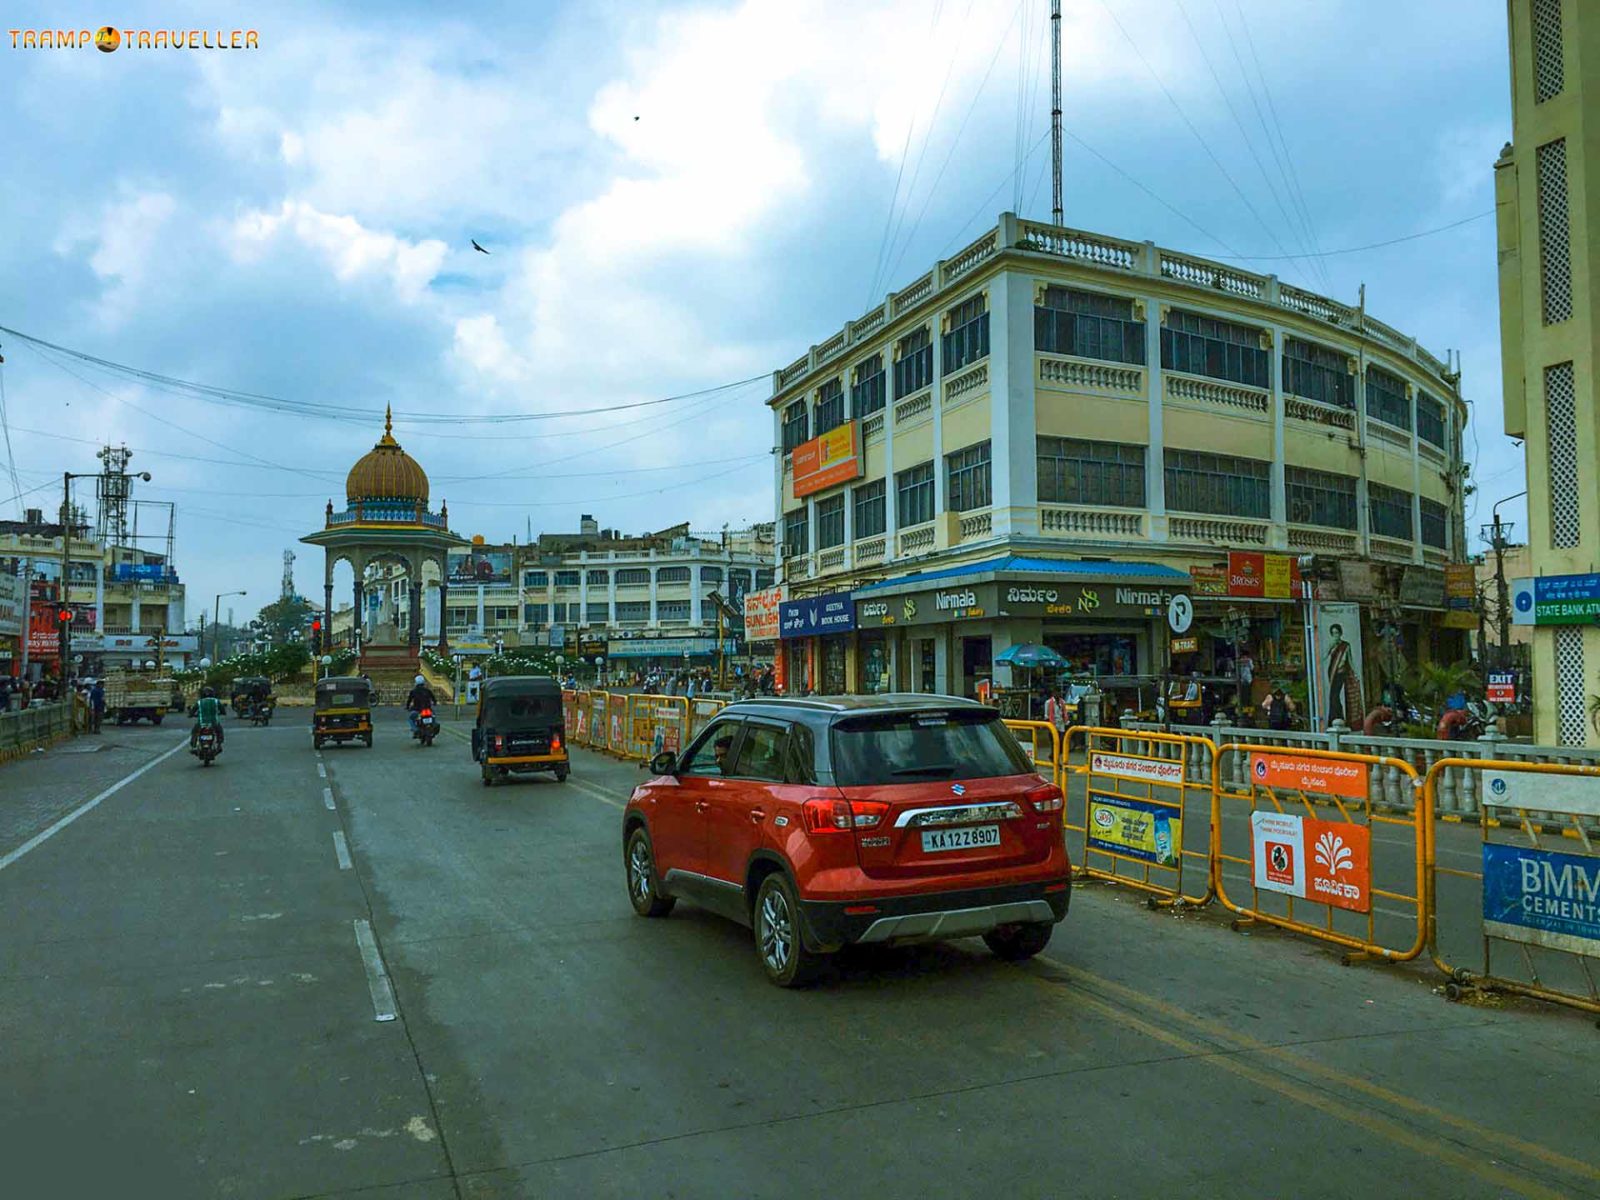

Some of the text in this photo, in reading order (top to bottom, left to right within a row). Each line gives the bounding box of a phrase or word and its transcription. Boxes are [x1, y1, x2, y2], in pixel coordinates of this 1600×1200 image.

[936, 588, 976, 611] Nirmala
[1537, 605, 1560, 616] STATE
[1562, 604, 1584, 615] BANK
[746, 612, 778, 628] SUNLIGH
[1489, 674, 1513, 684] EXIT
